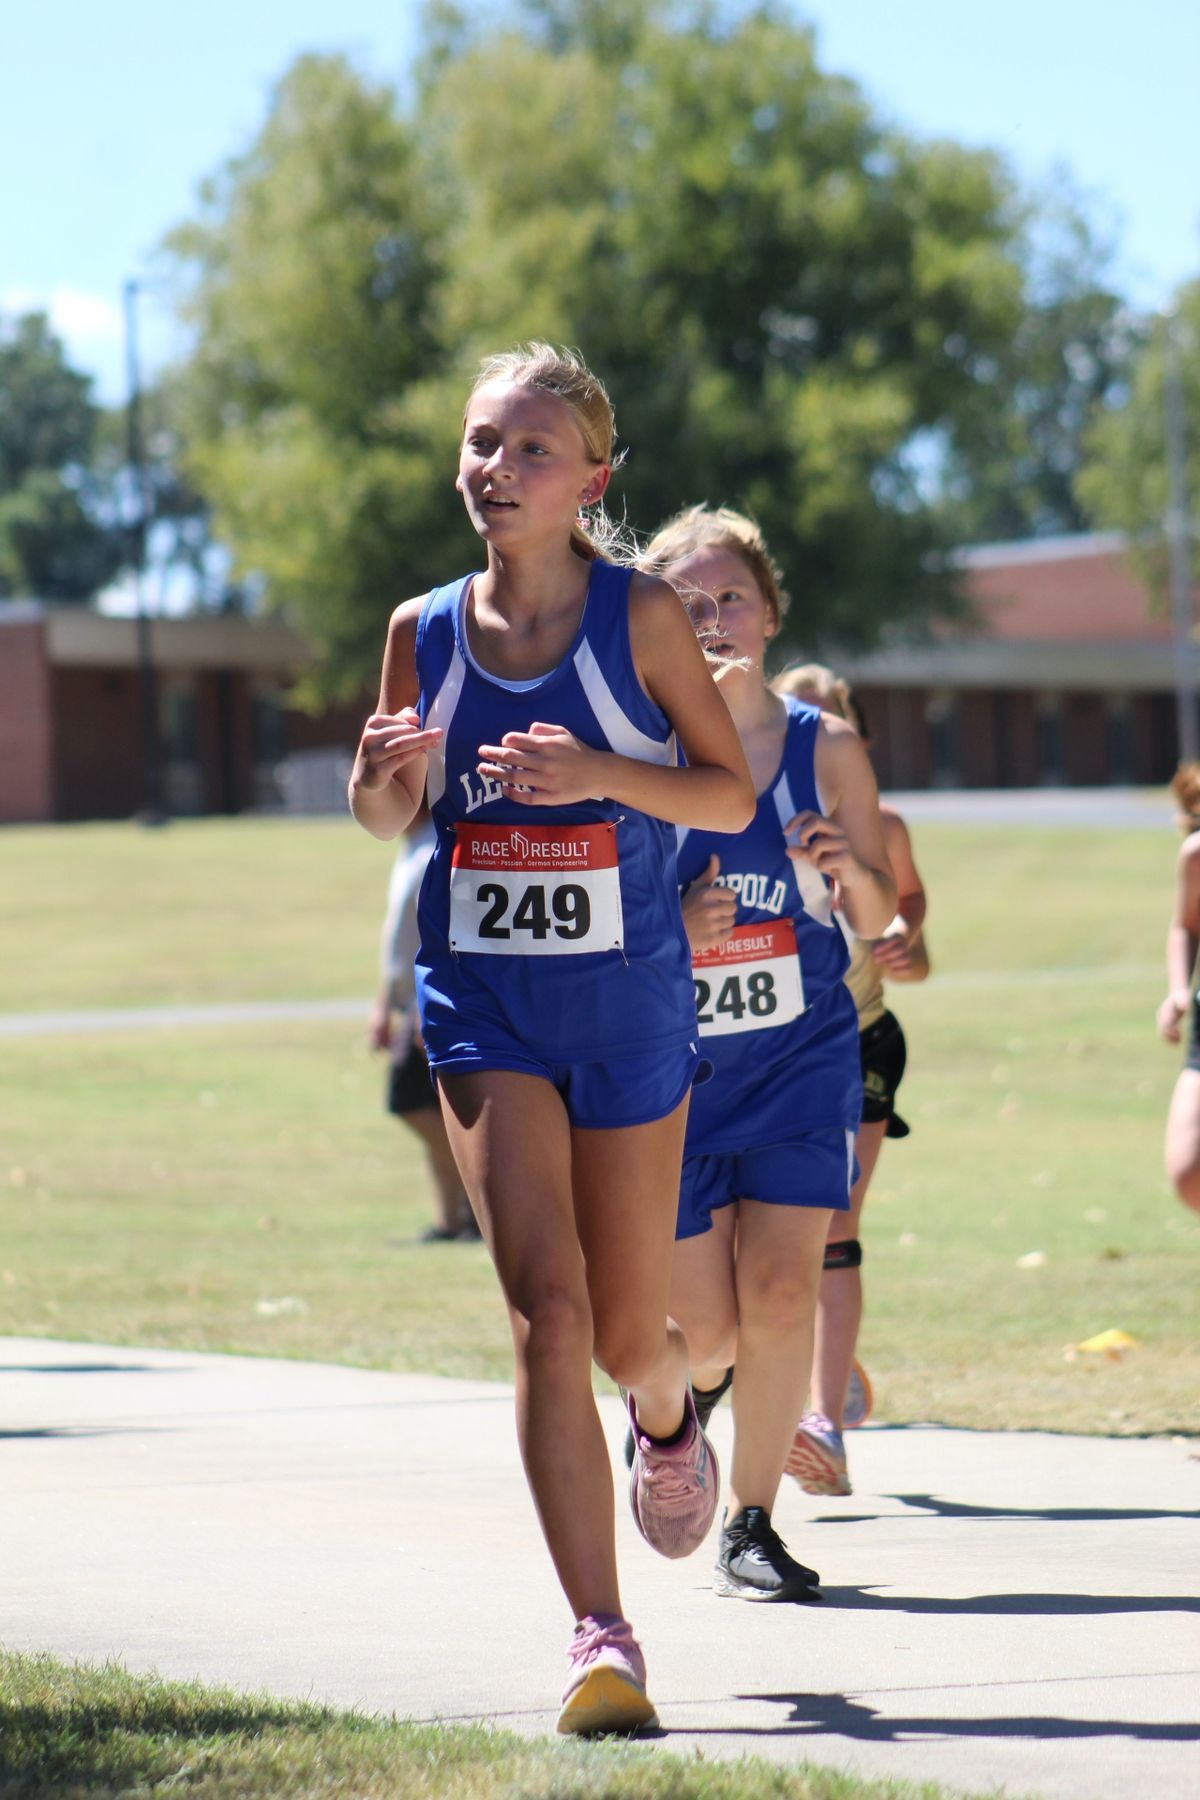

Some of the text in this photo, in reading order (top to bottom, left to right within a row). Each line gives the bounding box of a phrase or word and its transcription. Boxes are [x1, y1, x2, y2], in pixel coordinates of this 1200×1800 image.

[471, 840, 590, 857] RACE RESULT
[472, 858, 497, 866] Precision
[552, 859, 588, 867] Engineering
[476, 883, 591, 940] 249
[726, 934, 774, 954] RESULT
[694, 971, 777, 1024] 248
